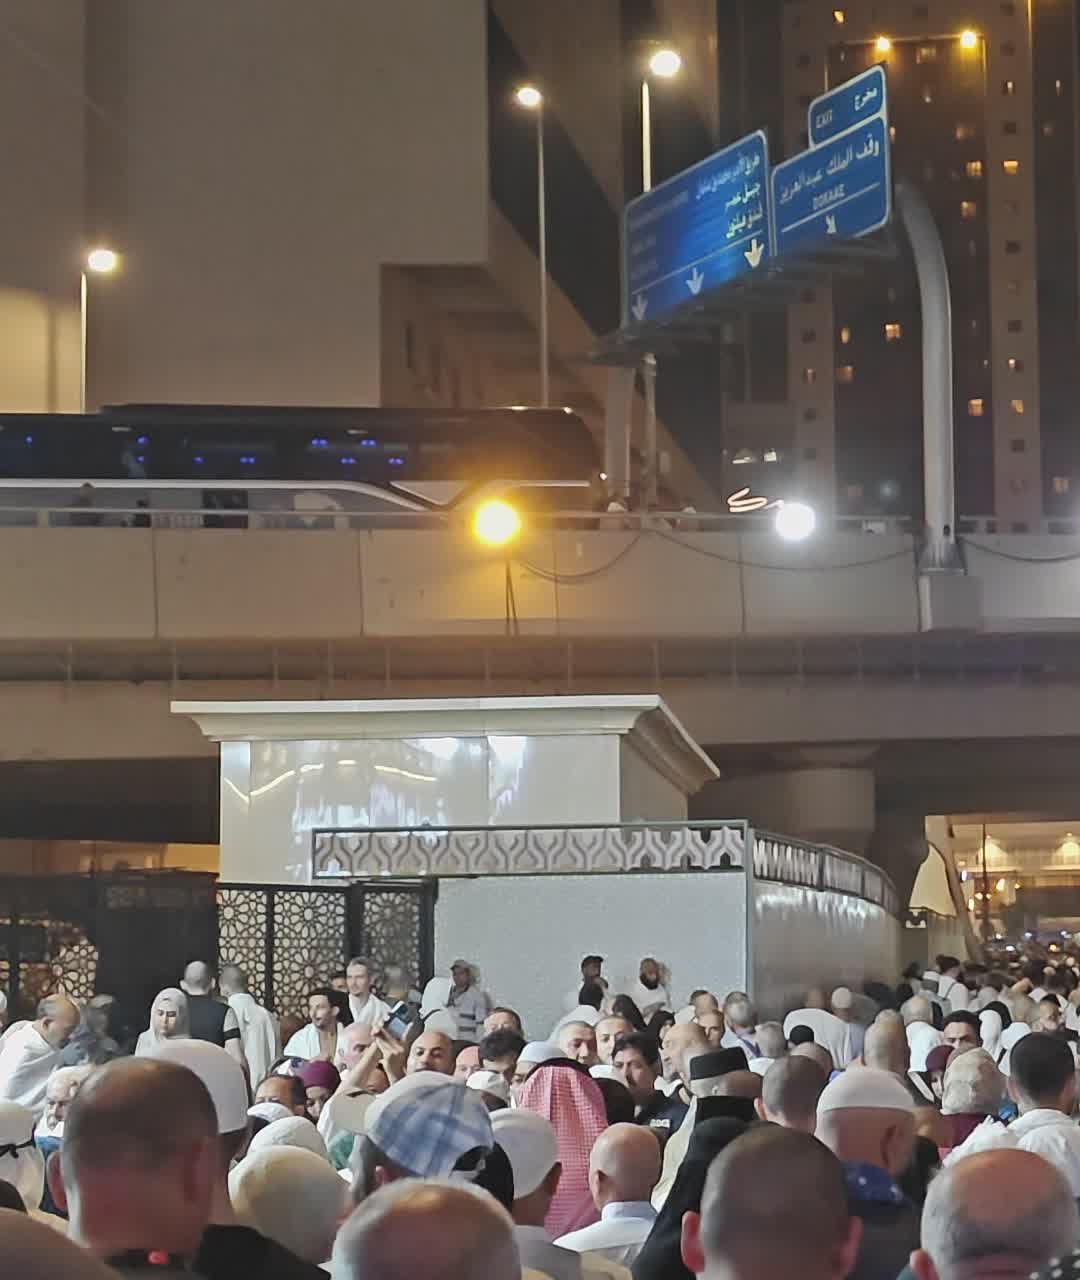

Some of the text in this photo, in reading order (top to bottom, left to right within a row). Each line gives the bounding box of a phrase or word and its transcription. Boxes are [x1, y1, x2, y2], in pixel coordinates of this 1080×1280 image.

[853, 86, 878, 112] مخرج
[815, 107, 833, 129] EXIT
[855, 132, 880, 162] وقف
[826, 147, 853, 176] الملك
